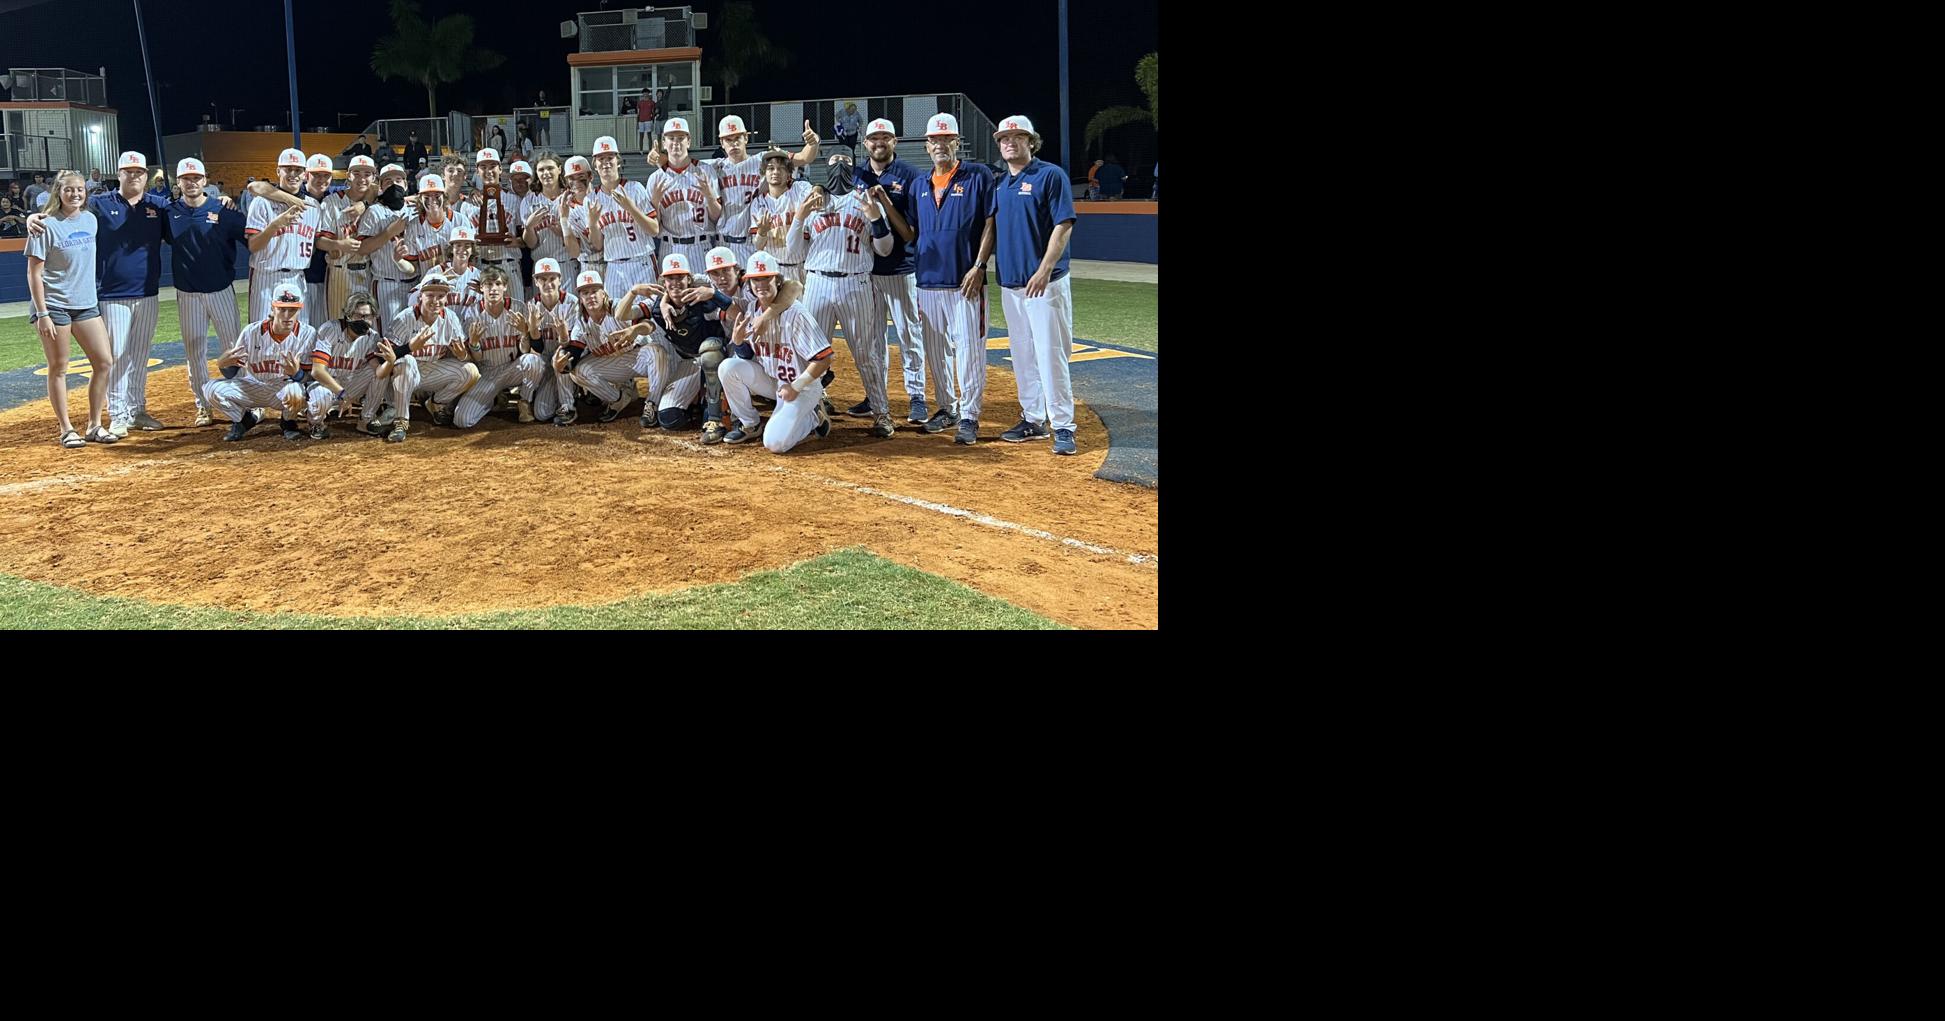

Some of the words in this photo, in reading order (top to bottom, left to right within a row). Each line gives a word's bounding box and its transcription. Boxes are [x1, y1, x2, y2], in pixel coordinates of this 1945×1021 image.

[672, 121, 682, 129] LB
[727, 123, 737, 131] LB
[936, 120, 948, 130] LB
[601, 143, 610, 151] LB
[692, 207, 705, 223] 12
[626, 226, 637, 242] 5
[846, 234, 860, 254] 11
[299, 241, 312, 258] 15
[670, 260, 680, 268] LB
[712, 256, 724, 265] LB
[755, 261, 766, 272] LB
[778, 365, 797, 382] 22
